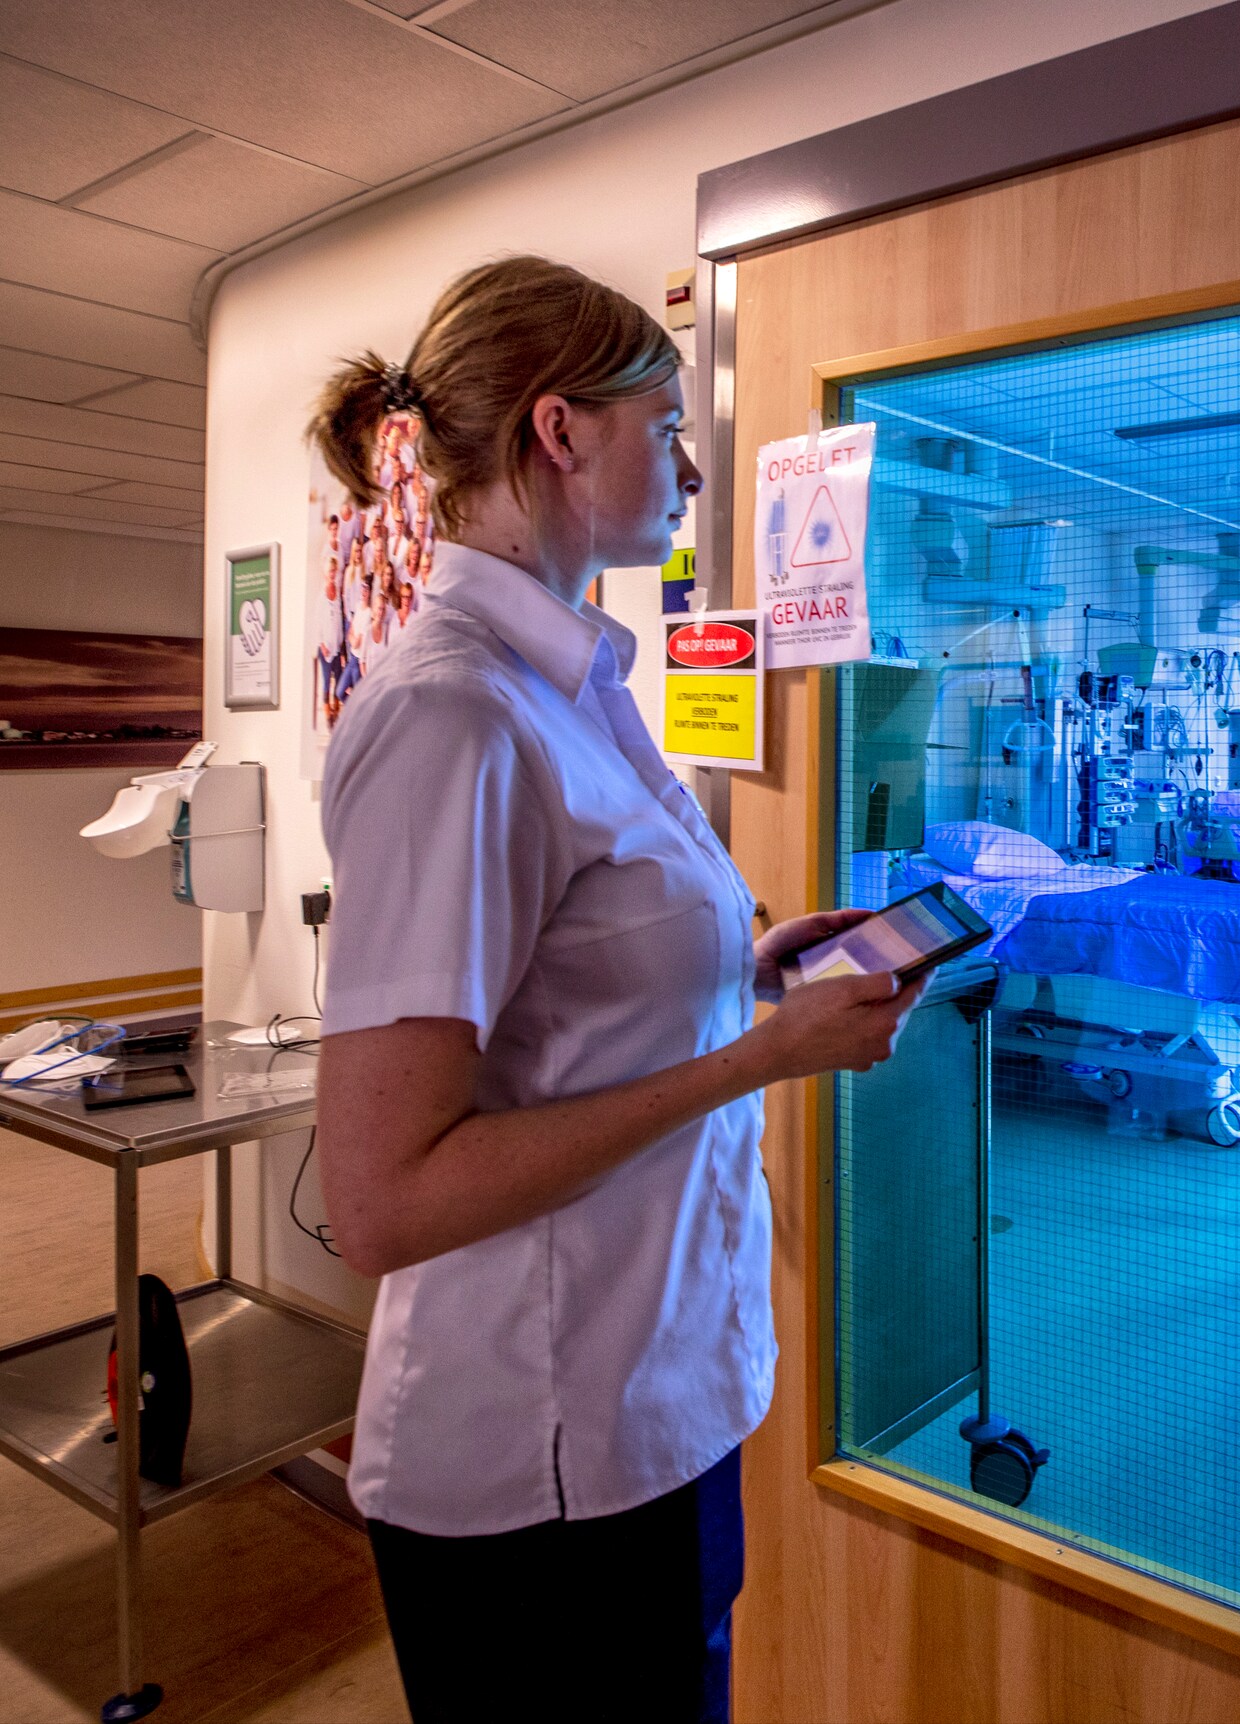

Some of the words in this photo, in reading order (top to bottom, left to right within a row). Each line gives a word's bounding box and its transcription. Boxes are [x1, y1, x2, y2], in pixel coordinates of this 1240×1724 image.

[768, 447, 857, 481] OPGELET
[684, 554, 696, 575] I
[764, 586, 817, 600] ULTRAVIOLETTE
[818, 581, 854, 594] STRALING
[772, 596, 849, 625] GEVAAR
[704, 638, 738, 652] GEVAAR
